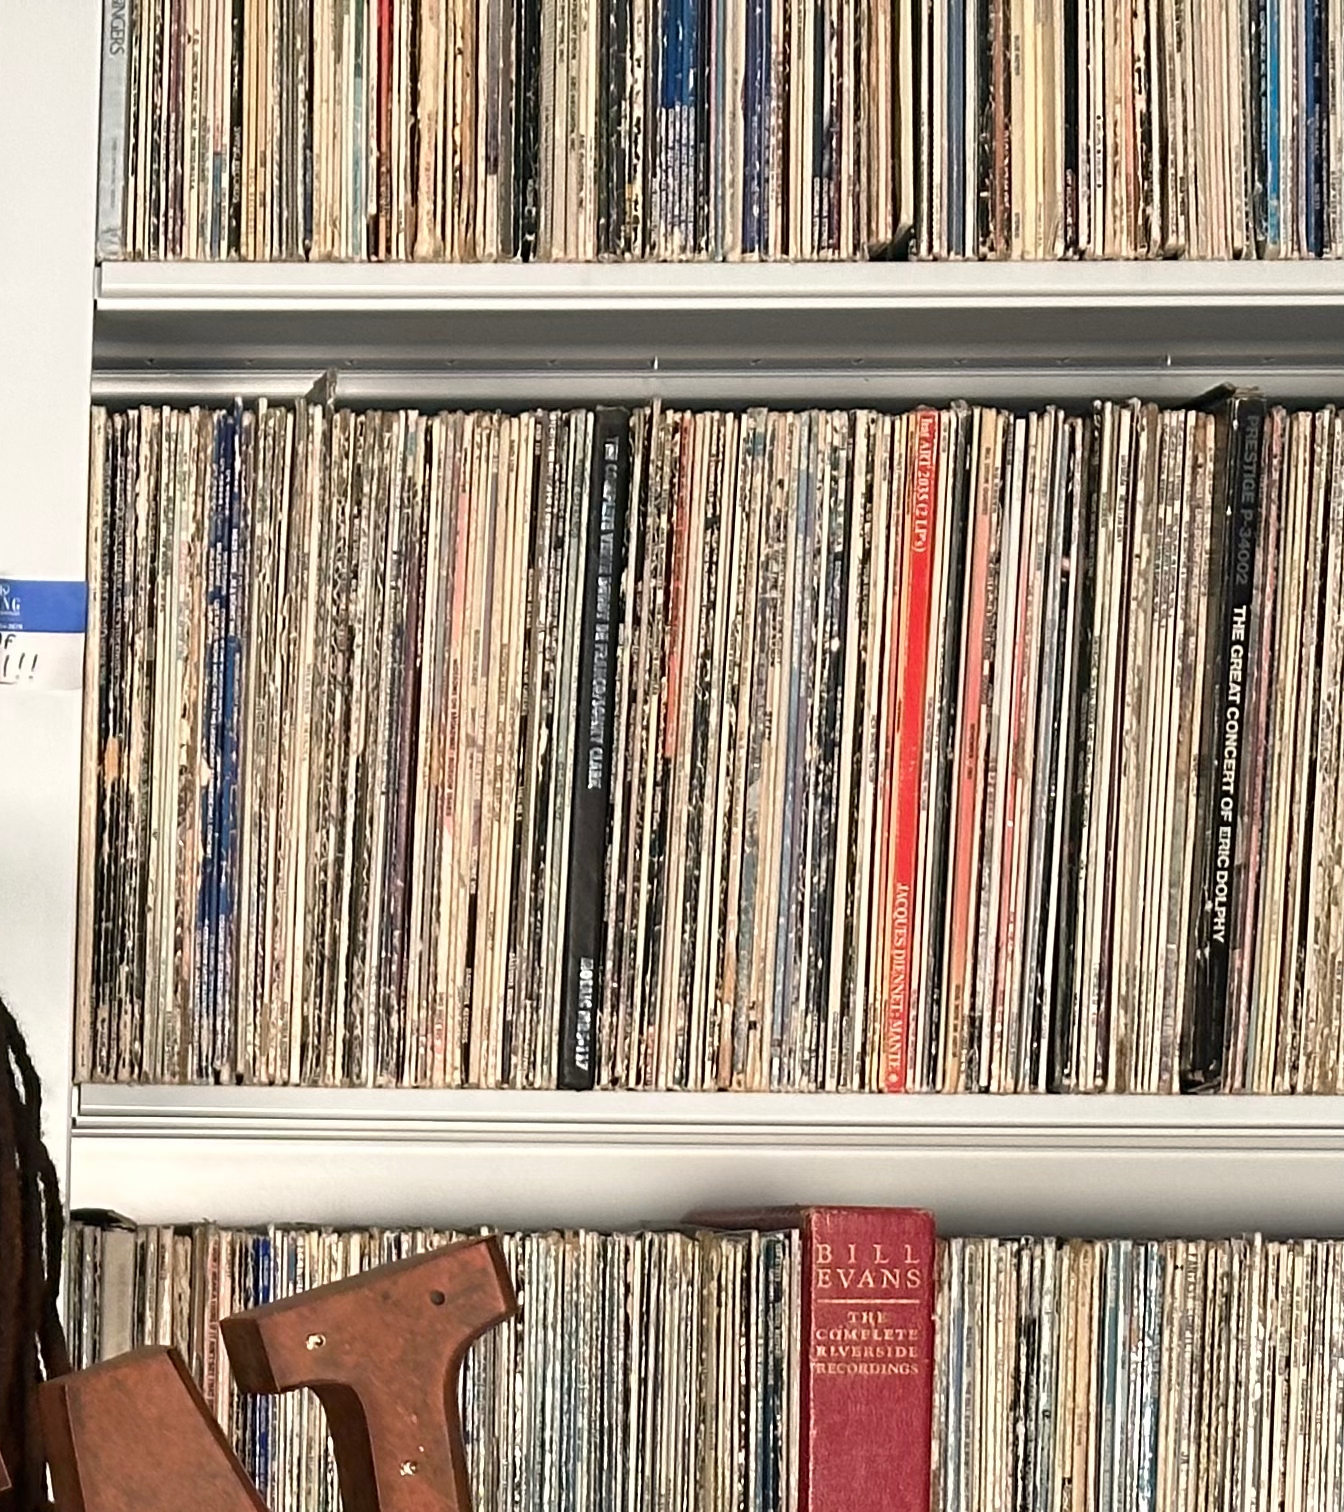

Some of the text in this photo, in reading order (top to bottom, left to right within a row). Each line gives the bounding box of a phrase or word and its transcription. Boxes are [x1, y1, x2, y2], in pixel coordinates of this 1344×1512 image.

[918, 440, 932, 469] ART
[1235, 415, 1259, 586] PRESTIGE P-34002
[1212, 605, 1247, 944] THE GREAT CONCERT OF ERIC DOLPHY
[887, 883, 910, 1069] JACQUES DIENNET: MANTE
[815, 1243, 922, 1290] BILL EVANS
[846, 1310, 889, 1325] THE
[815, 1327, 919, 1341] COMPLETE
[815, 1345, 919, 1359] RIVERSIDE
[815, 1361, 920, 1375] RECORDINGS
